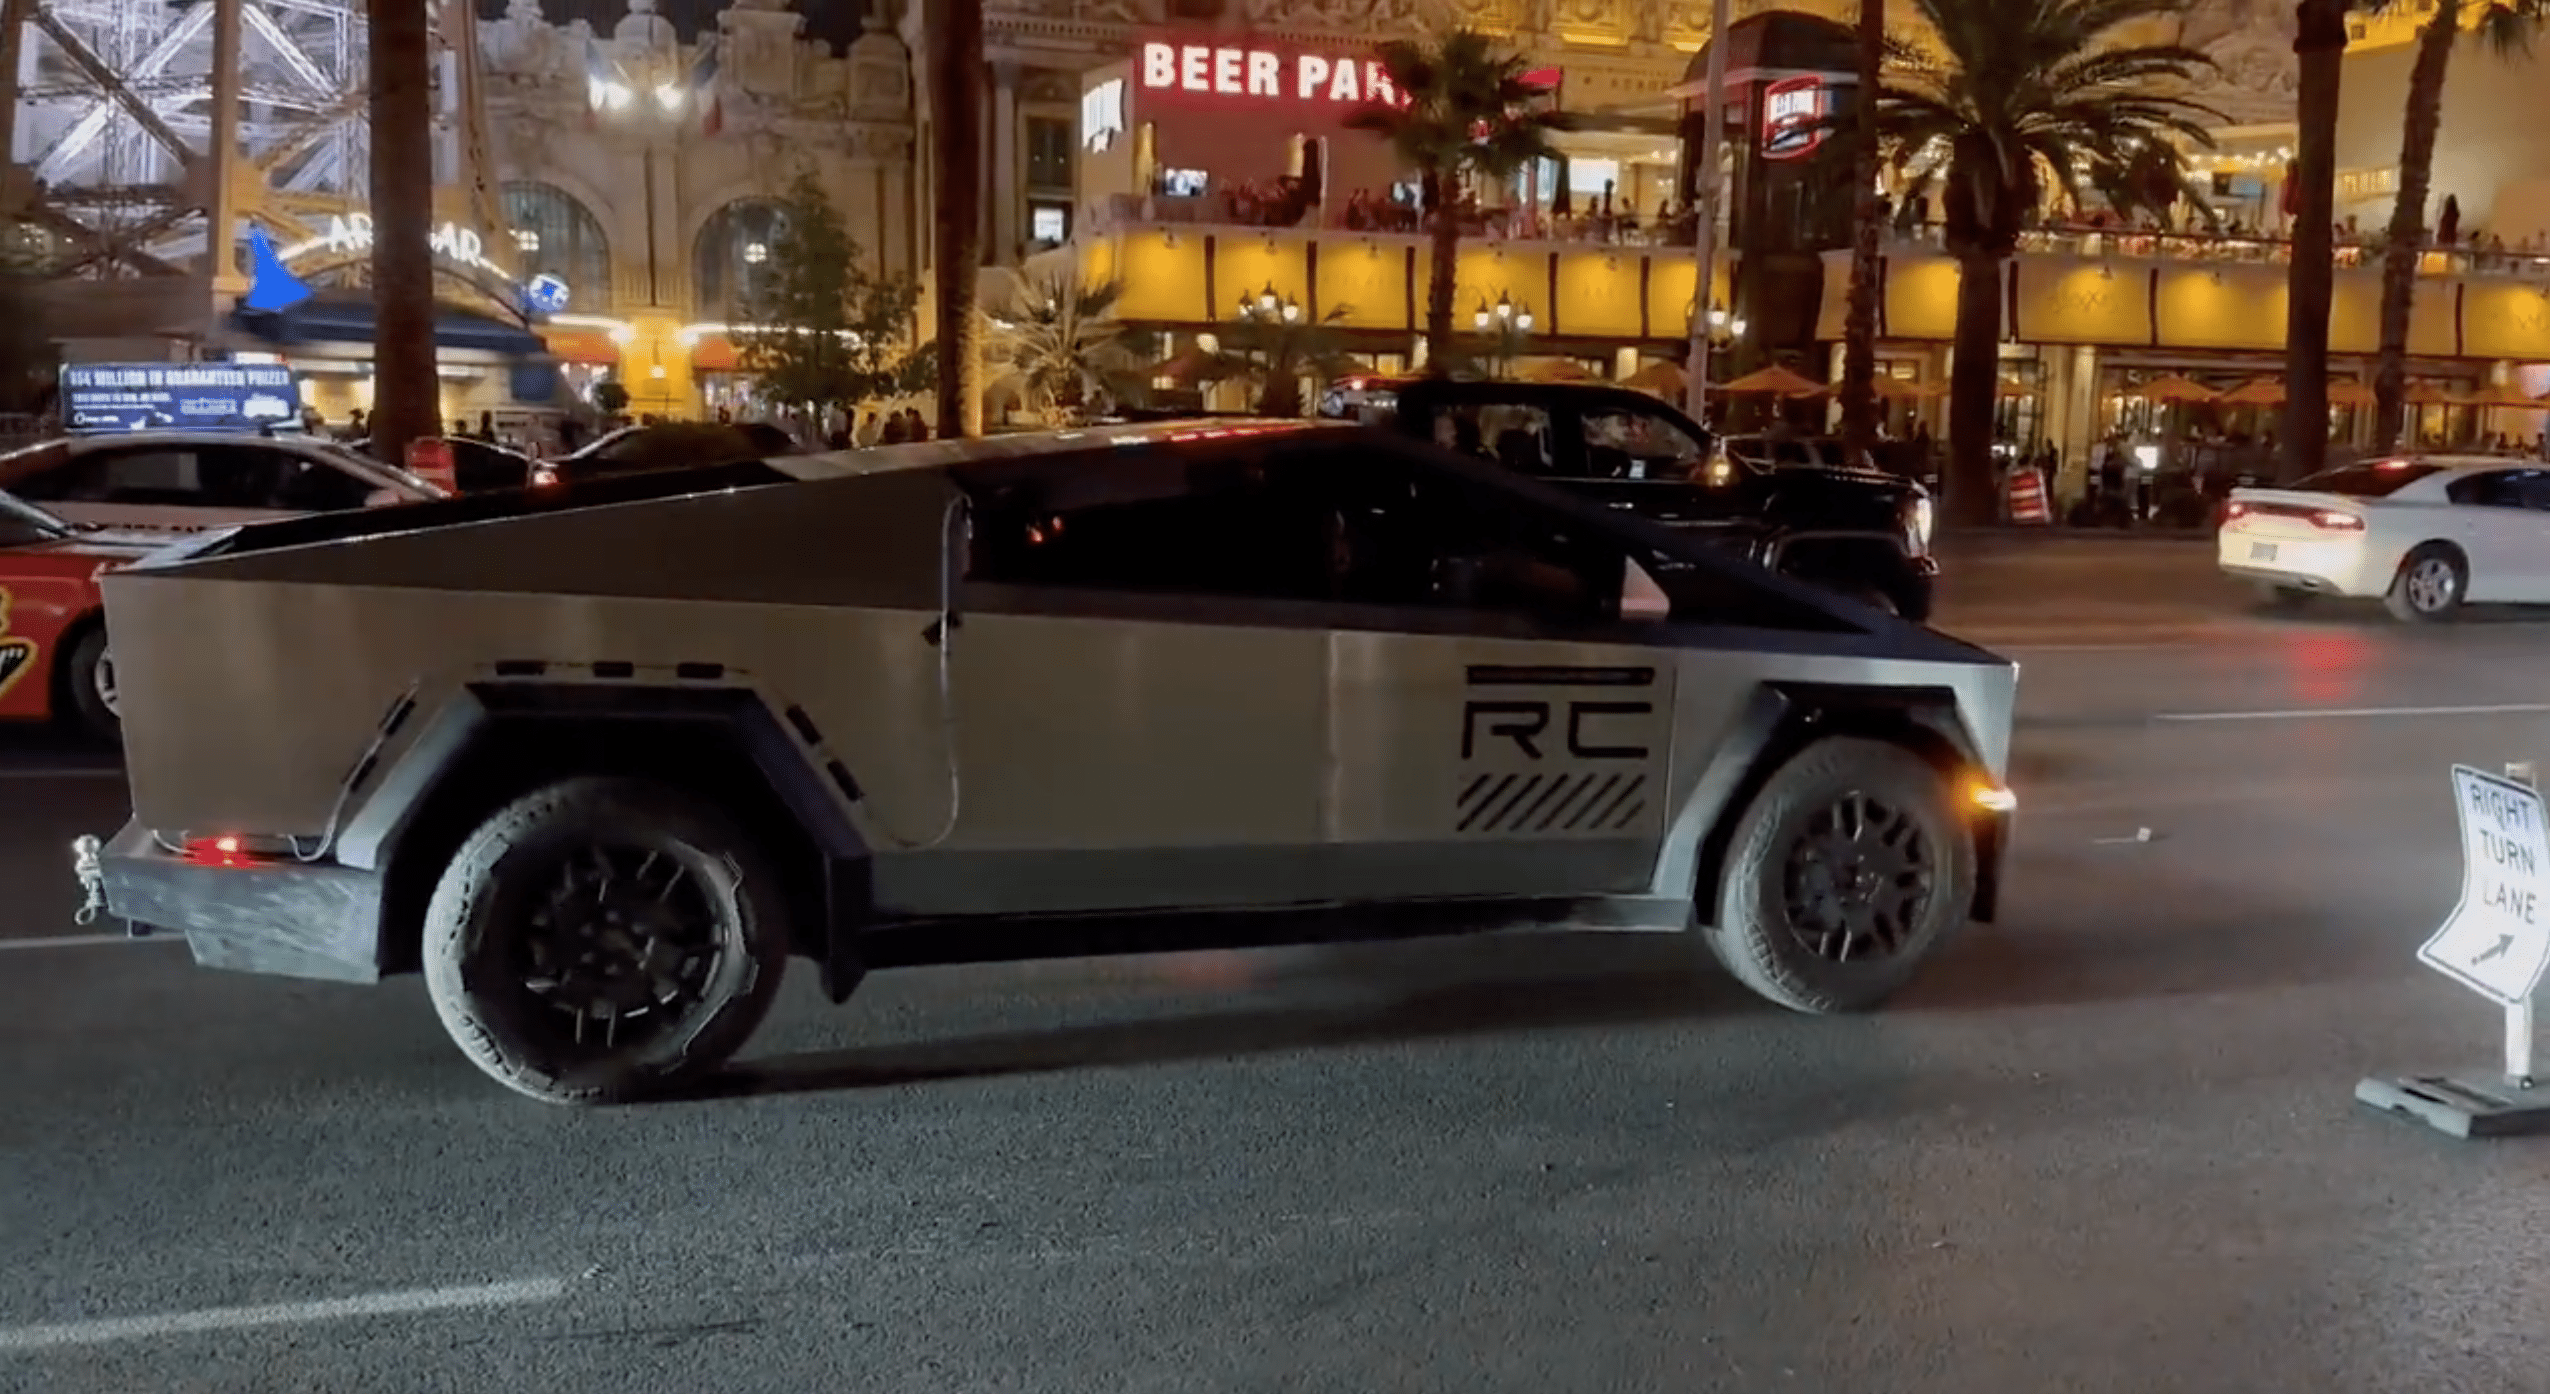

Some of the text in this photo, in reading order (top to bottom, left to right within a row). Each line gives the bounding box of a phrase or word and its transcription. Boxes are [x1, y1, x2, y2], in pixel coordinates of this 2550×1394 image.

[1144, 42, 1413, 106] BEER PAR
[430, 221, 482, 267] AR
[1461, 701, 1653, 759] RC
[2470, 783, 2530, 832] RIGHT
[2479, 828, 2536, 877] TURN
[2483, 881, 2537, 925] LANE
